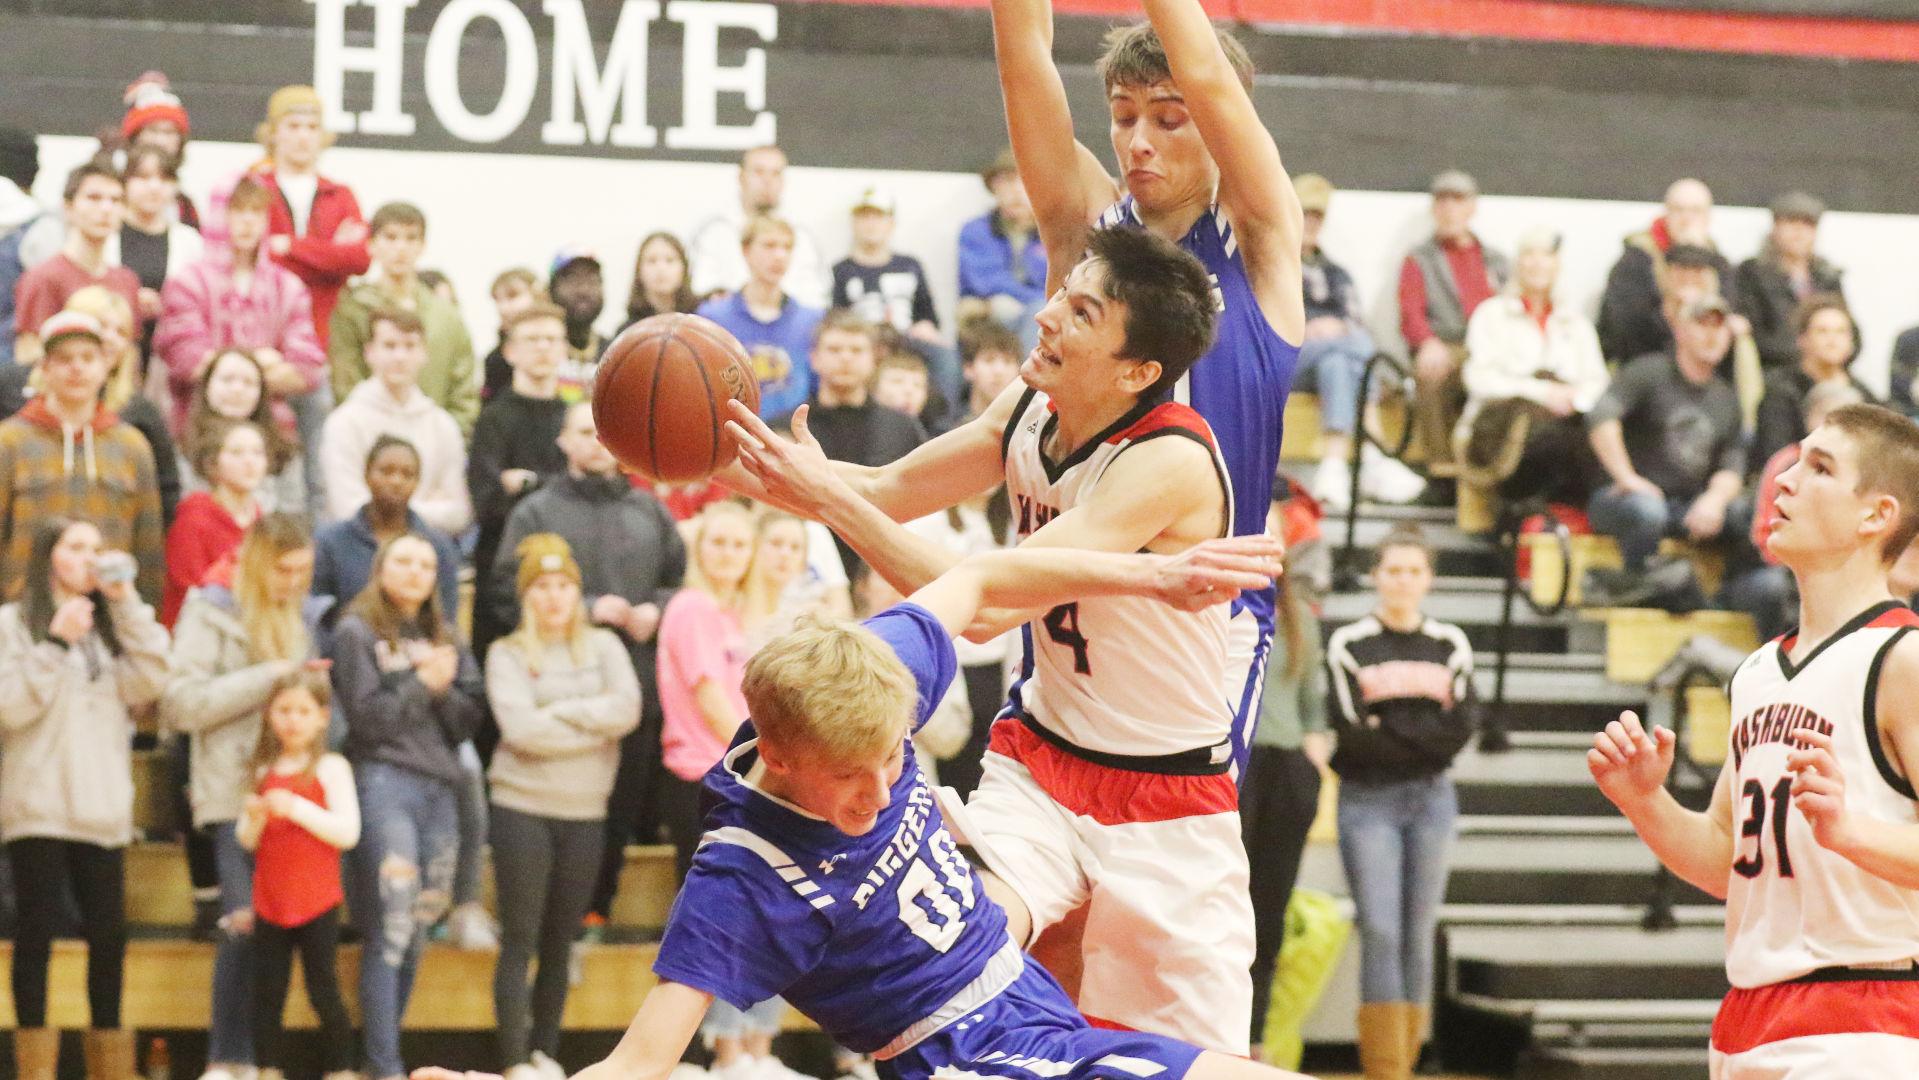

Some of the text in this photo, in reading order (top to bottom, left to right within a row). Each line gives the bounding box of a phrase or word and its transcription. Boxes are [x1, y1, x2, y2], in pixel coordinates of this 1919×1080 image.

[305, 0, 779, 150] HOME
[1042, 601, 1092, 677] 4
[1733, 776, 1795, 879] 31
